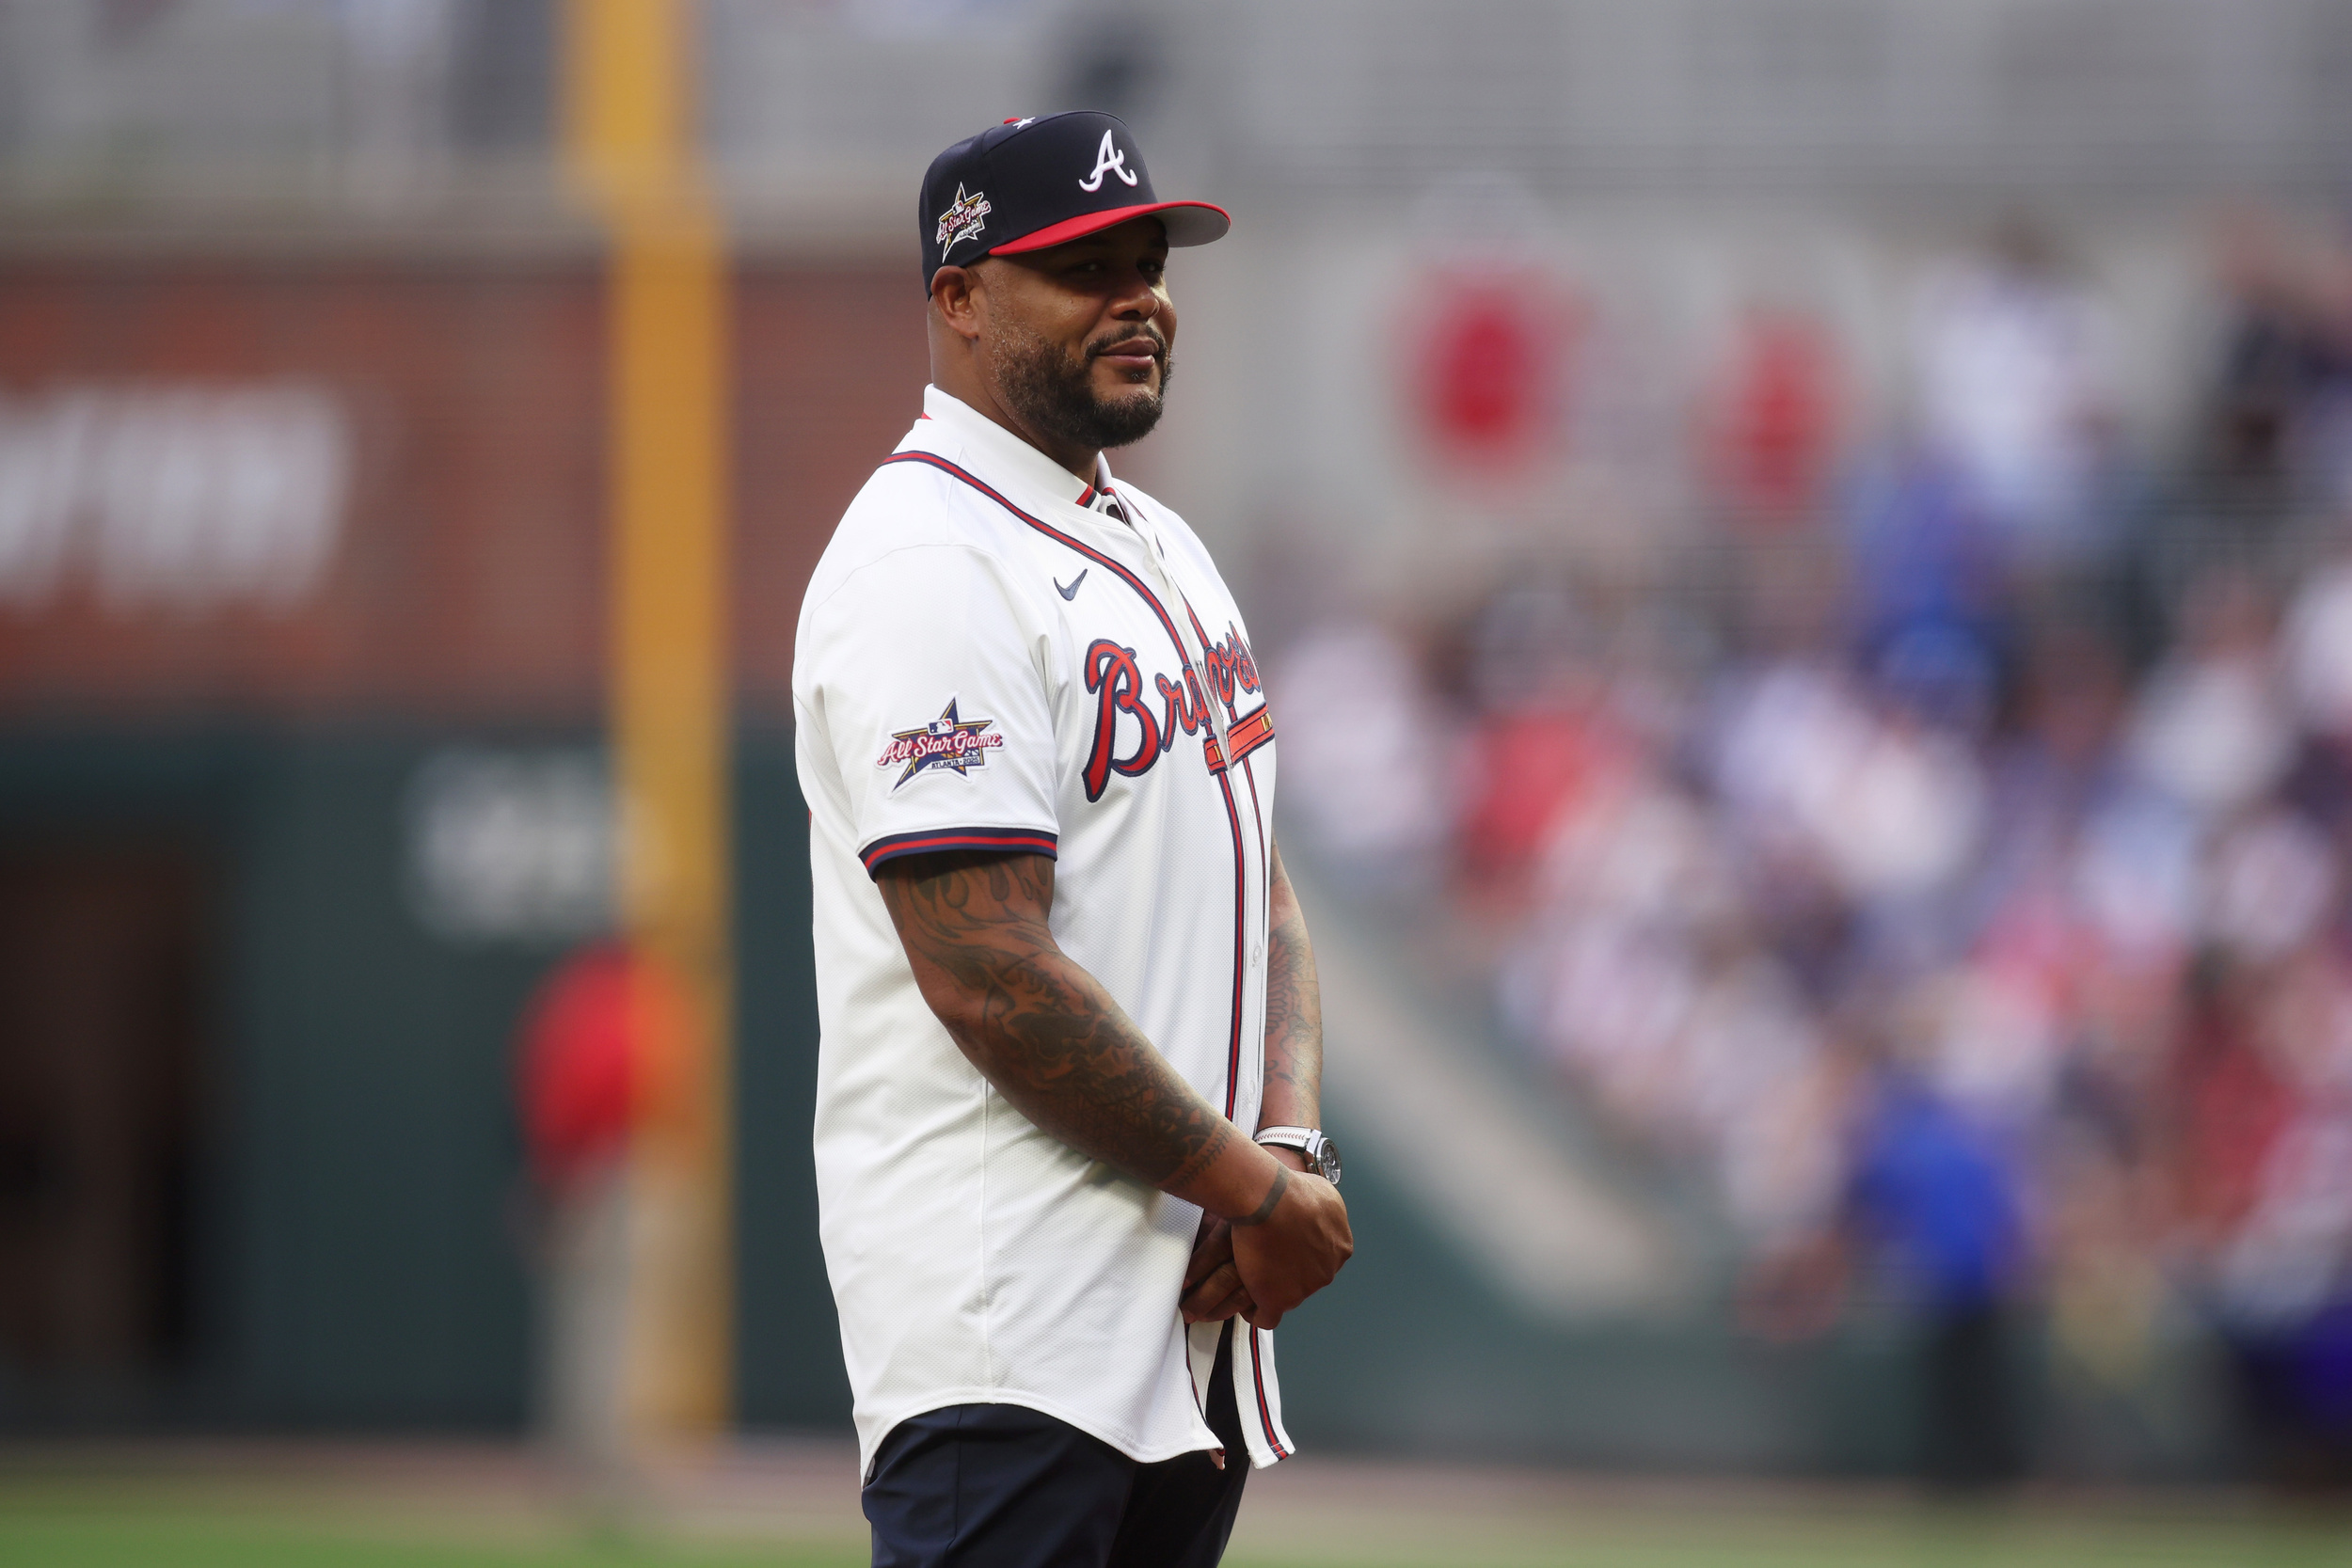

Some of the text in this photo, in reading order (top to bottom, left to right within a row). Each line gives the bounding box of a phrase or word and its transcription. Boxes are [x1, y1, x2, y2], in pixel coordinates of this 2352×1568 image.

[1079, 129, 1137, 192] A
[948, 213, 965, 232] Star
[964, 200, 991, 223] Game
[877, 730, 1003, 767] All Star Game
[931, 759, 960, 769] ATLANTA
